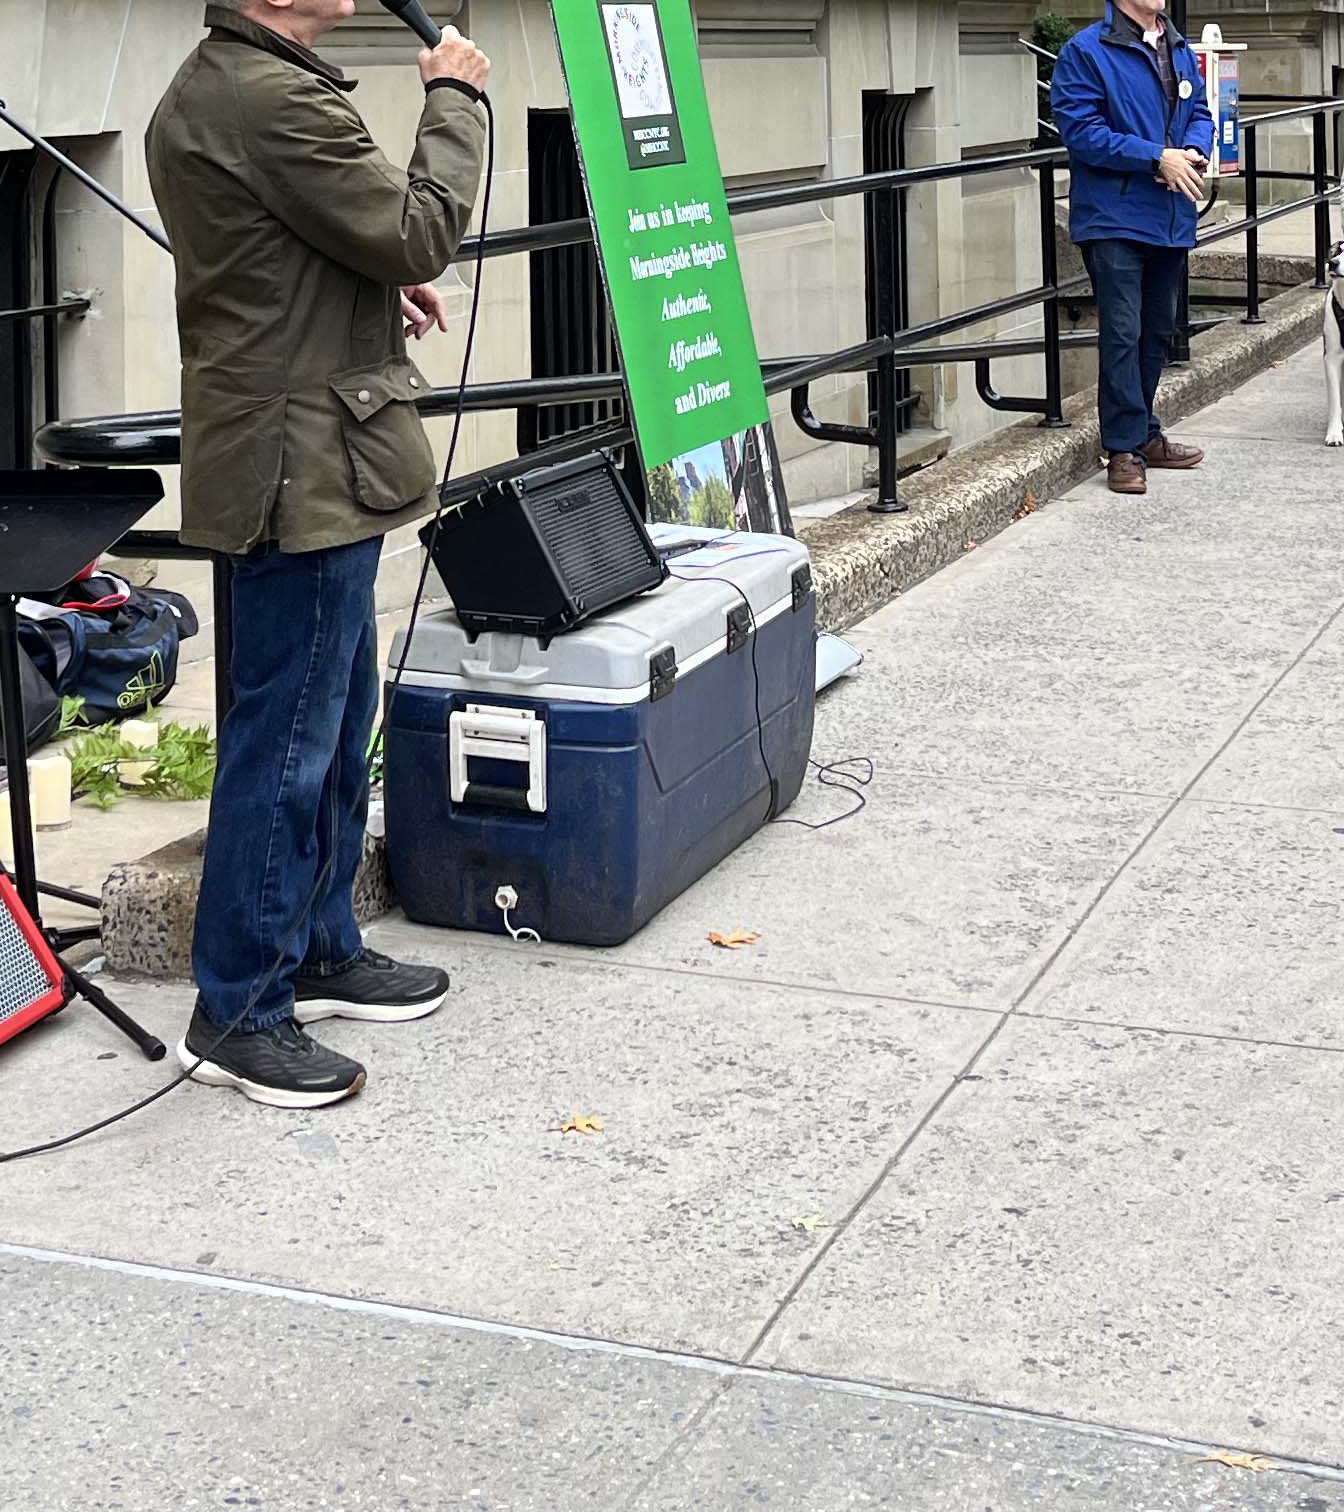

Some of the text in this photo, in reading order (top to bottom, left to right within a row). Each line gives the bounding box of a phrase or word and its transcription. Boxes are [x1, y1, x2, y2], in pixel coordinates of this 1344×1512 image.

[627, 198, 712, 233] Join us in keeping
[629, 240, 727, 280] Morningside Heights
[674, 386, 697, 415] and
